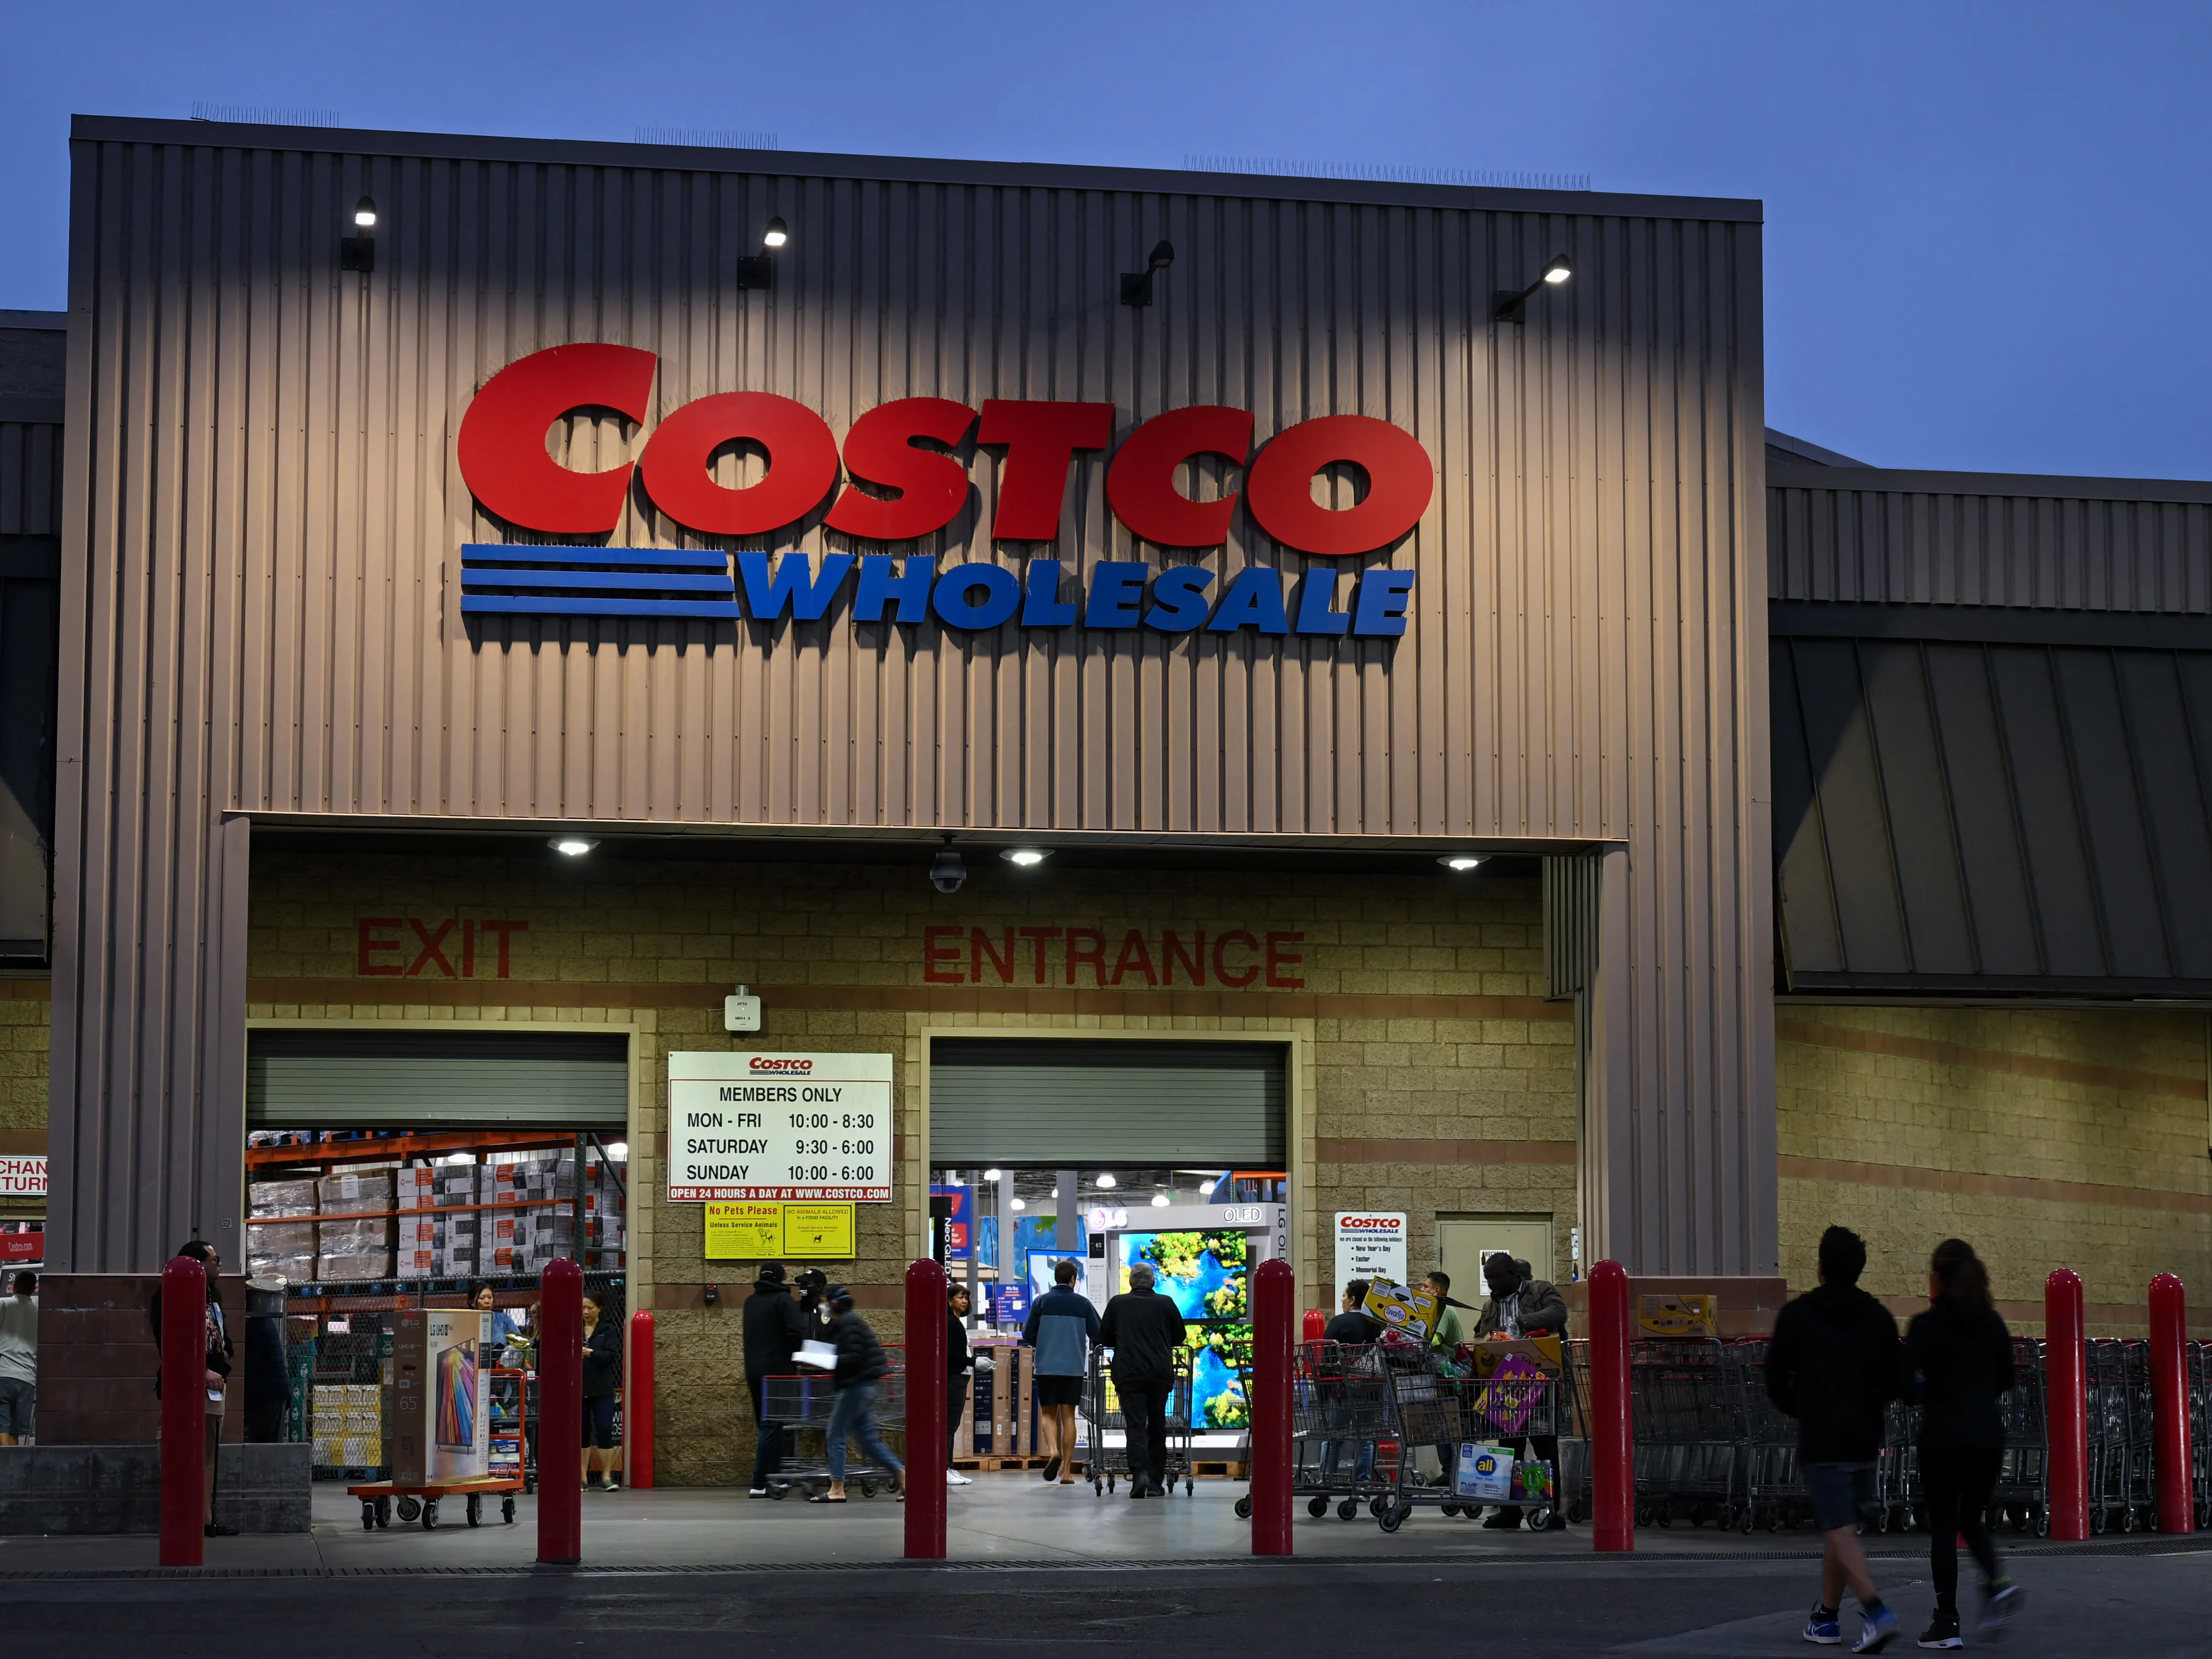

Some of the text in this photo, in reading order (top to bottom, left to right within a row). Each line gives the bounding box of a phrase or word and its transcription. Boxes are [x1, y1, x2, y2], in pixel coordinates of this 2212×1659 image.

[457, 341, 1435, 556] COSTCO
[737, 550, 1415, 636] WHOLESALE
[358, 917, 529, 978] EXIT
[923, 926, 1305, 988] ENTRANCE
[749, 1057, 813, 1069] COSTCO
[720, 1087, 842, 1102] MEMBERS ONLY
[688, 1113, 722, 1128] MON
[738, 1113, 761, 1128] FRI
[789, 1113, 828, 1128] 10:00
[842, 1114, 874, 1128] 8:30
[687, 1139, 768, 1154] SATURDAY
[796, 1140, 828, 1154] 9:30
[842, 1140, 874, 1154] 6:00
[687, 1165, 749, 1180] SUNDAY
[788, 1166, 827, 1180] 10:00
[841, 1166, 873, 1181] 6:00
[0, 1176, 47, 1190] TUR
[671, 1188, 889, 1199] OPEN 24 HOURS A DAY AT WWW.COSTCO.COM
[709, 1206, 777, 1215] No Pets Please
[1106, 1209, 1127, 1227] LG
[1223, 1207, 1262, 1223] OLED
[1278, 1208, 1285, 1228] LG
[1340, 1216, 1401, 1228] COSTCO
[8, 1242, 33, 1252] Costco.com
[1385, 1306, 1405, 1321] favorita
[430, 1324, 435, 1336] LG
[436, 1324, 444, 1336] UHD
[1477, 1459, 1493, 1472] all
